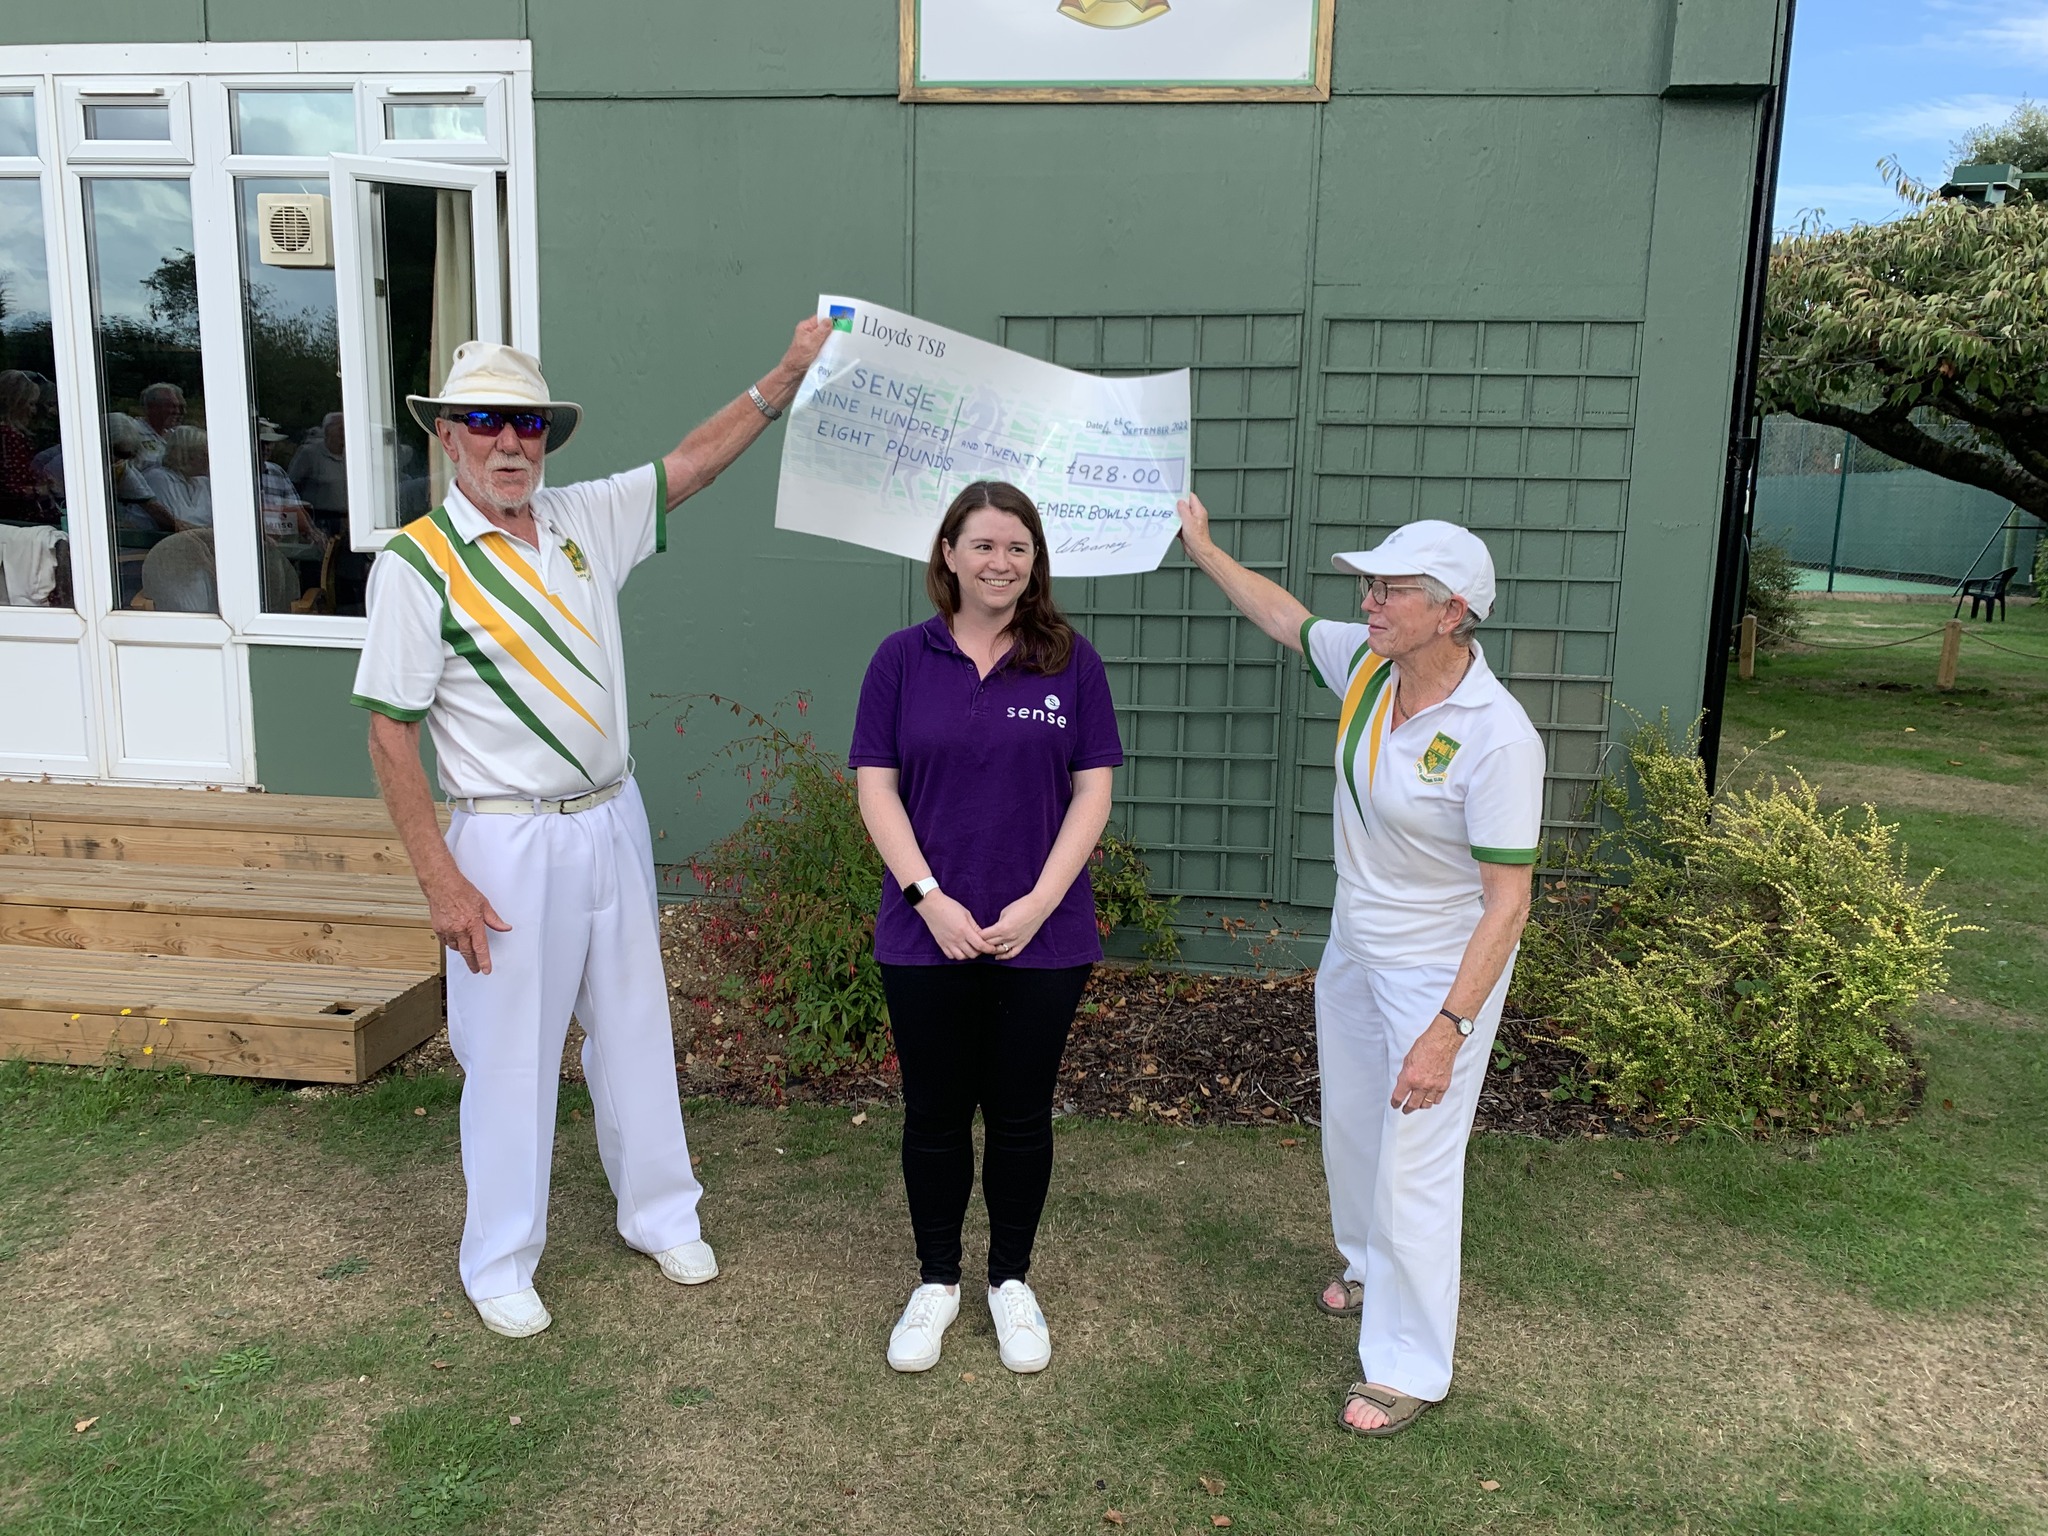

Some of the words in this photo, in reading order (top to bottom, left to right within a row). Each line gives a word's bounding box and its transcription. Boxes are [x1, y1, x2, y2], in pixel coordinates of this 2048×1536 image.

[861, 315, 914, 348] Lloyds
[917, 335, 947, 358] TSB
[817, 366, 833, 378] Pay
[852, 368, 937, 412] SENSE
[811, 388, 861, 414] NINE
[870, 405, 950, 441] HUNDRED
[961, 441, 979, 451] AND
[984, 442, 1047, 468] TWENTY
[1085, 420, 1103, 430] Date
[817, 420, 875, 447] EIGHT
[885, 440, 954, 472] POUNDS
[1036, 501, 1086, 519] EMBER
[1088, 504, 1133, 520] BOWLS
[1135, 506, 1174, 519] CLUB
[1006, 706, 1067, 729] sense
